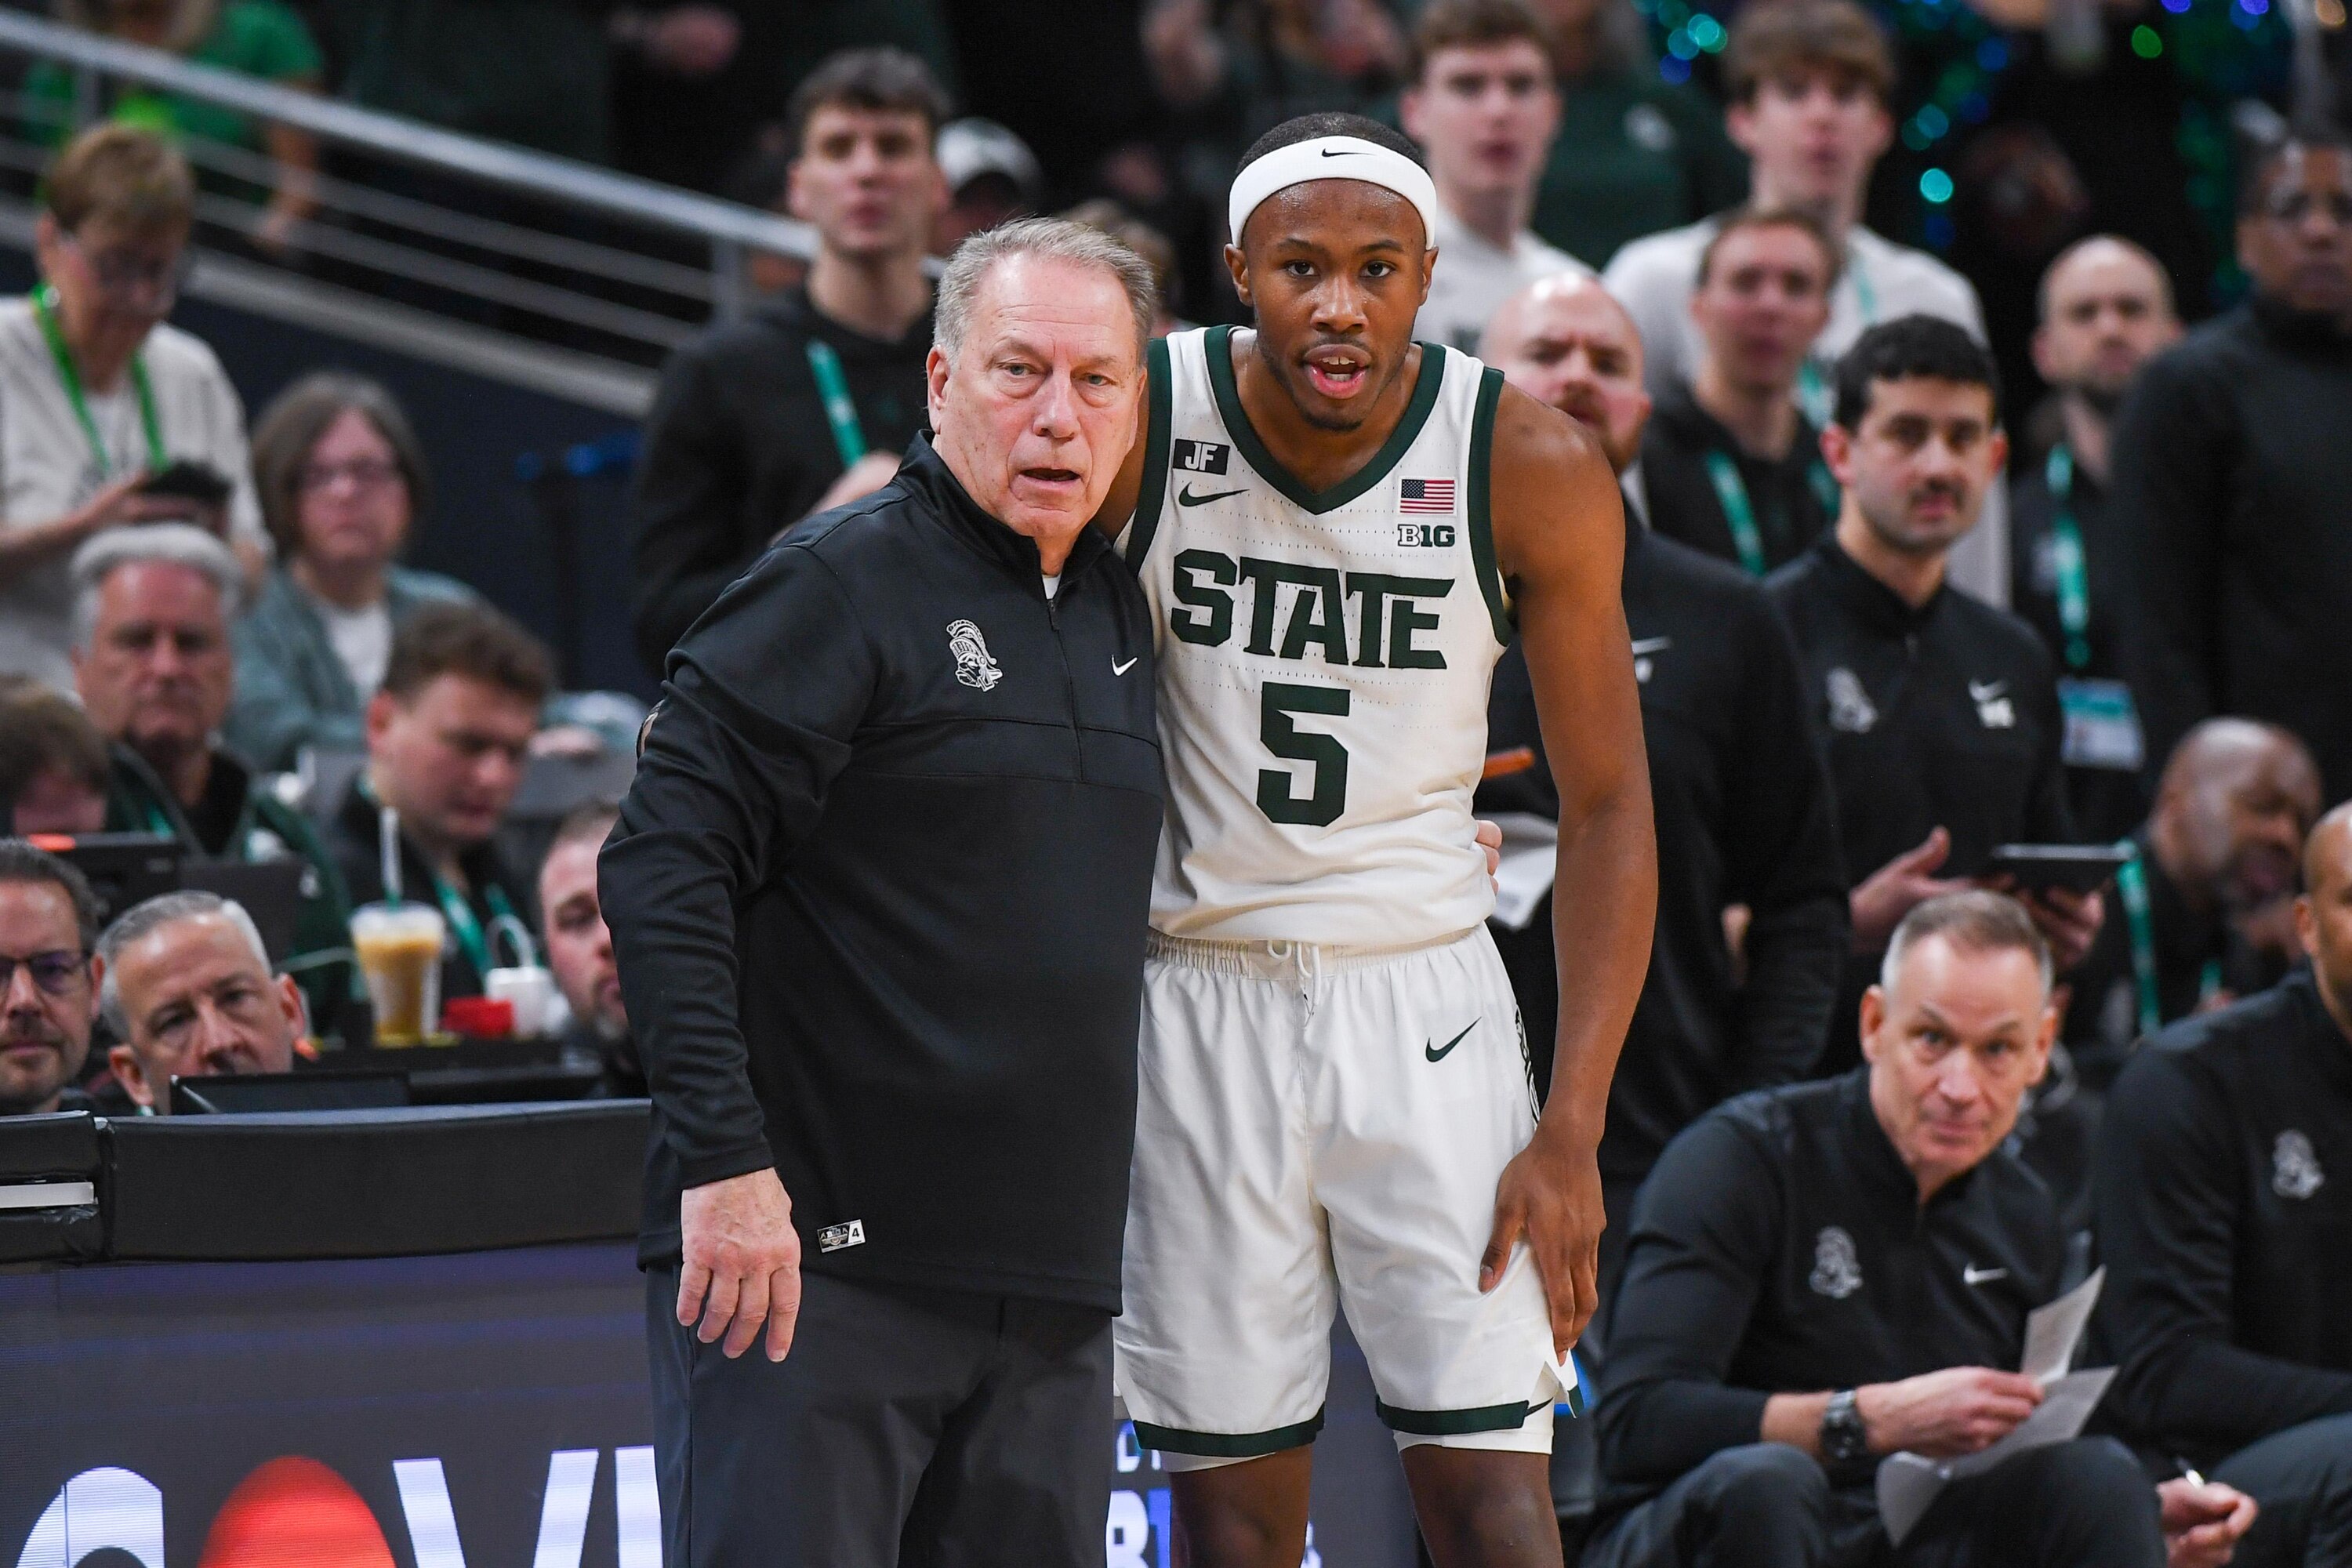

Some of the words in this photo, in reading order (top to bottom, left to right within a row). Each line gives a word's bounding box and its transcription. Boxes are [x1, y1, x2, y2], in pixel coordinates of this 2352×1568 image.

[1184, 442, 1219, 471] JF
[1170, 548, 1456, 670] STATE
[1256, 681, 1351, 827] 5
[851, 1227, 860, 1238] 4
